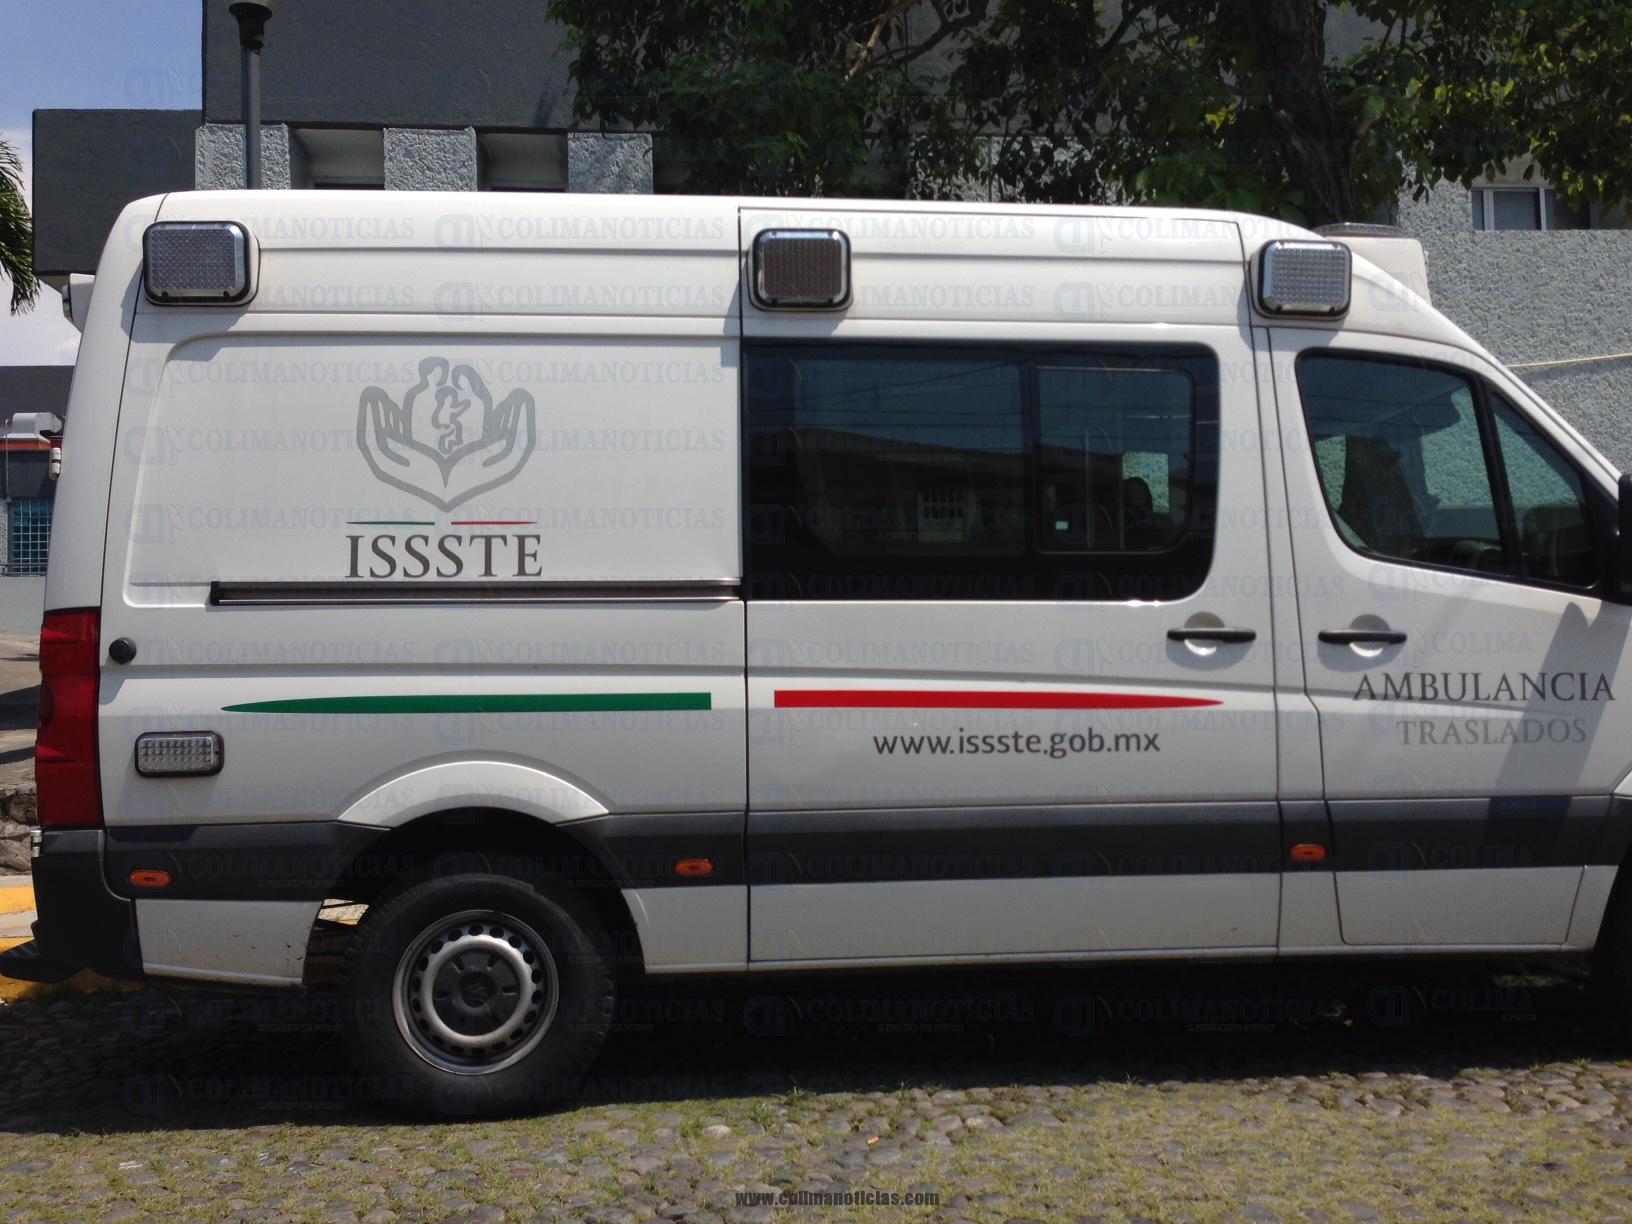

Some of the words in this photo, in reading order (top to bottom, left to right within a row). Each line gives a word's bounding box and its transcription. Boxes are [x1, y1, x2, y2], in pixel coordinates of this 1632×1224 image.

[345, 534, 543, 579] ISSSTE
[1352, 672, 1616, 701] AMBULANCIA
[873, 727, 1160, 759] www.issste.gob.mx
[1396, 718, 1587, 746] TRASLADOS
